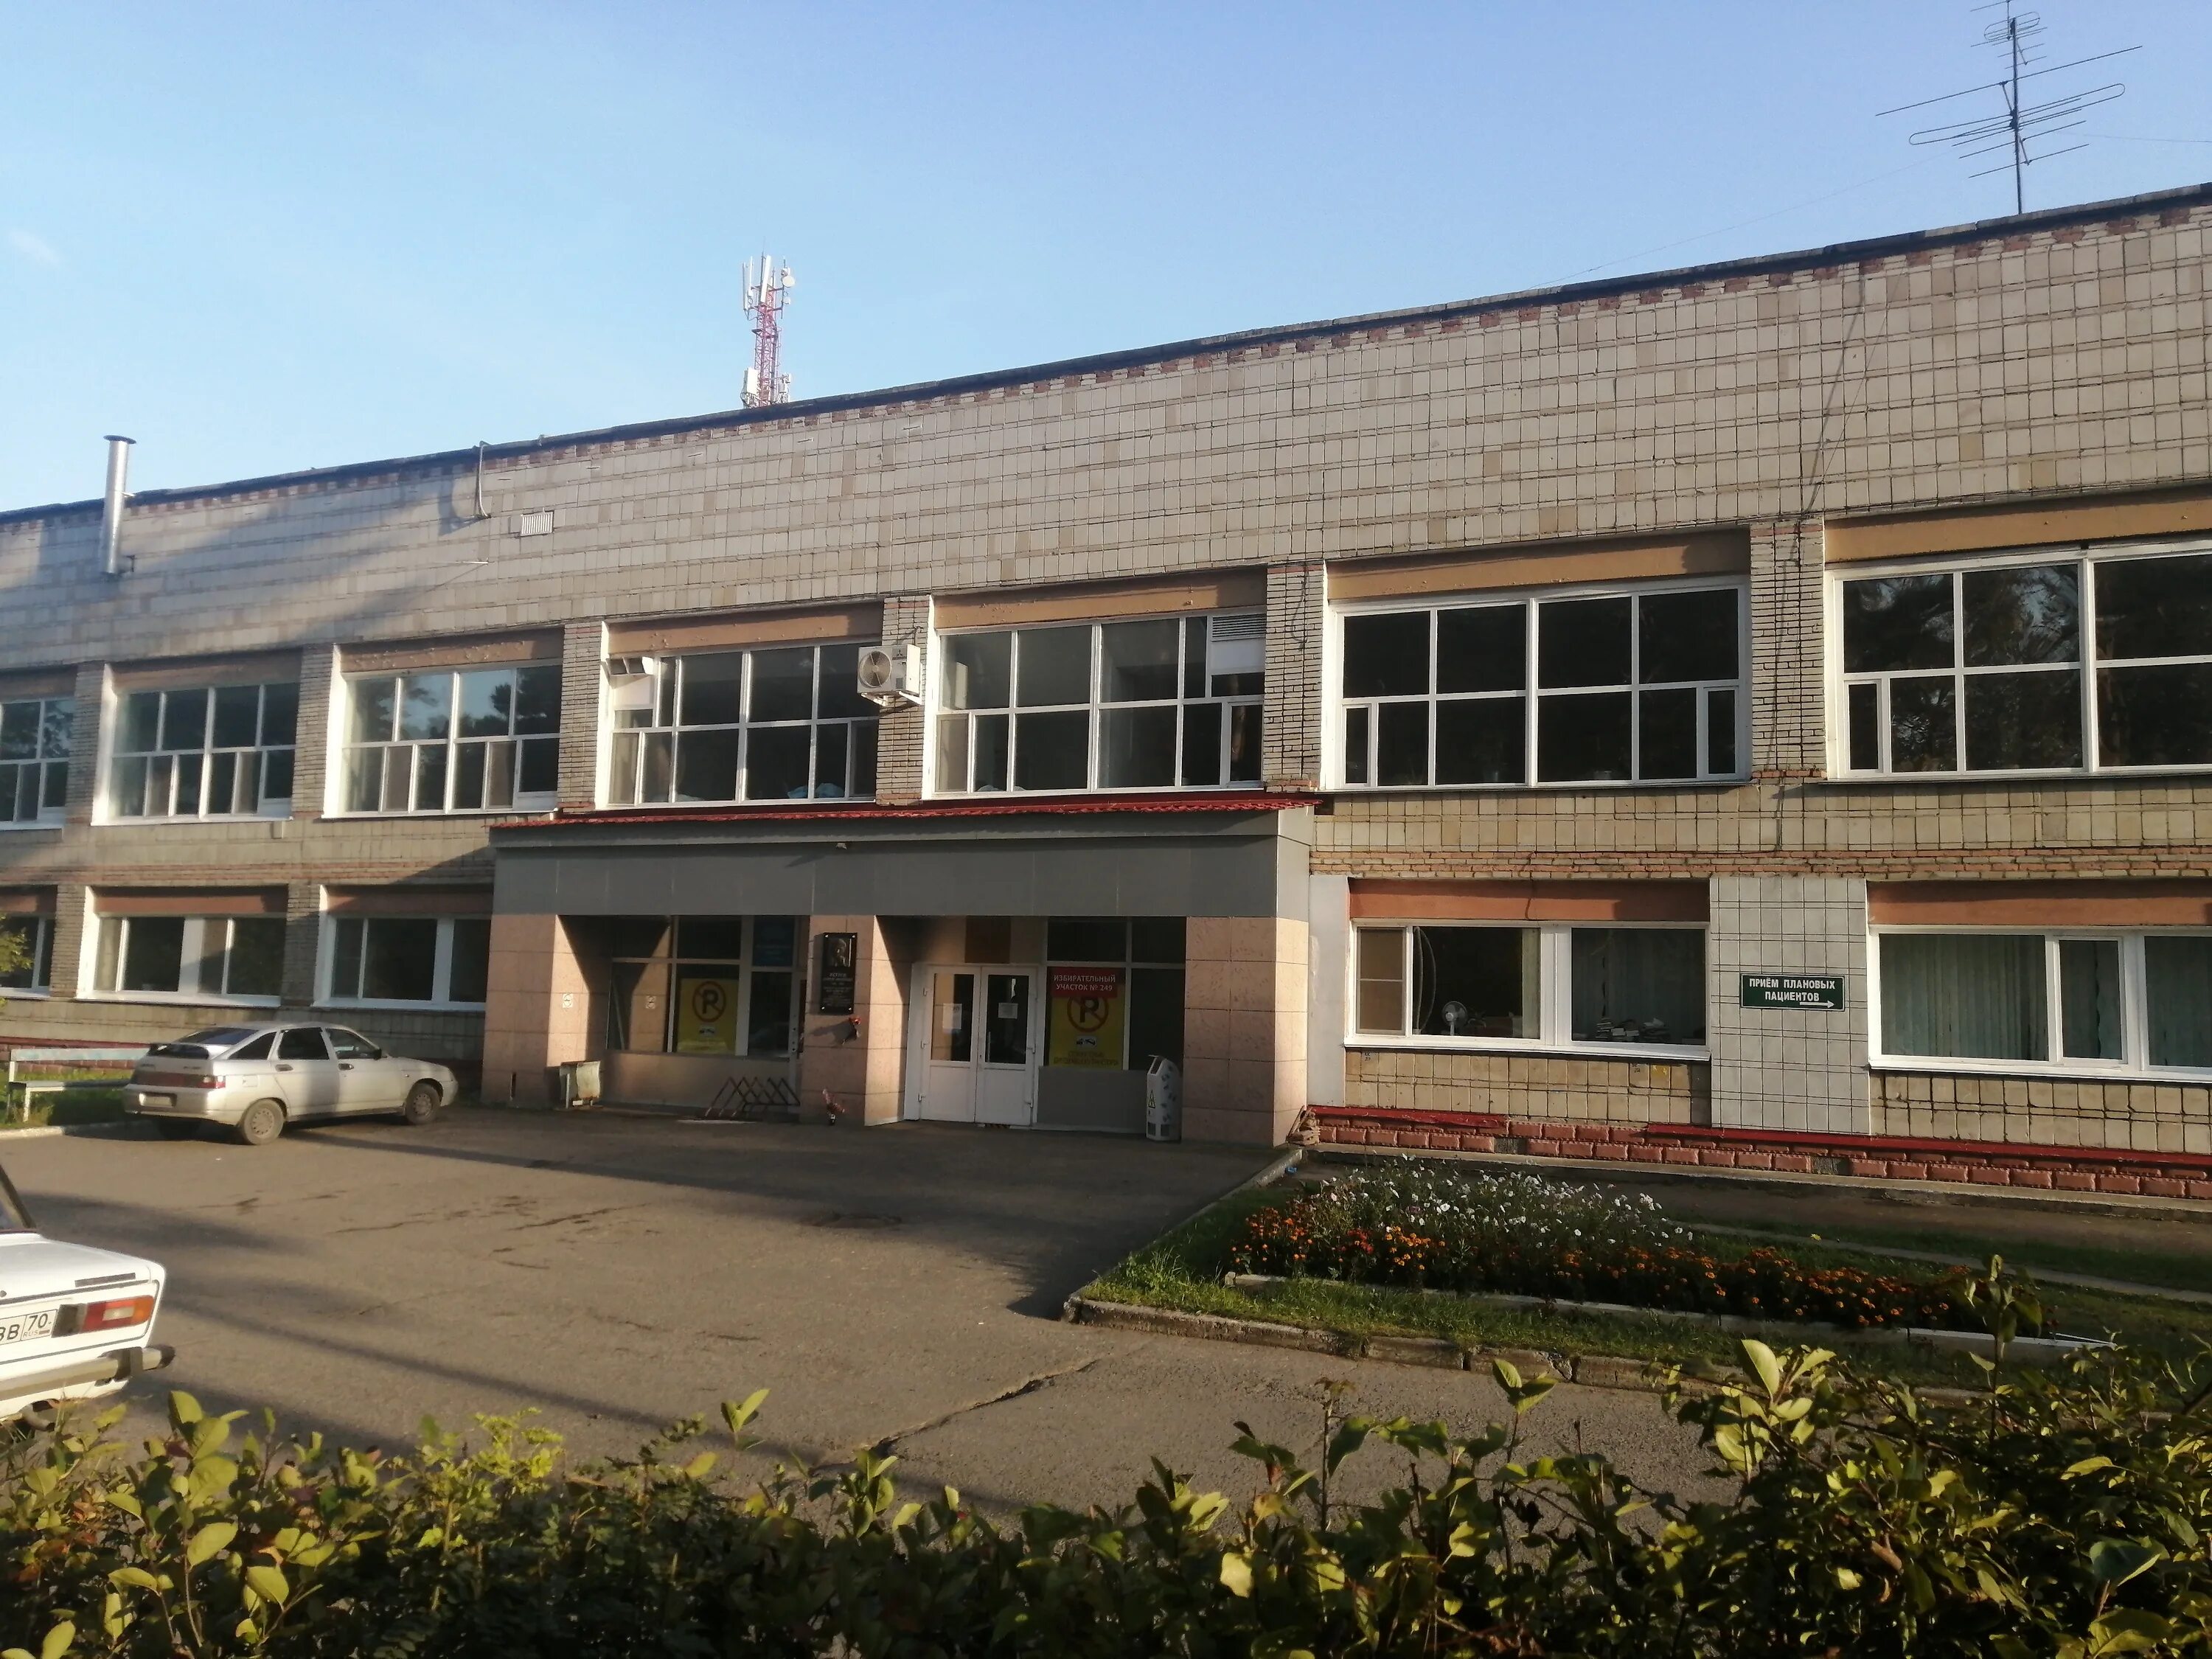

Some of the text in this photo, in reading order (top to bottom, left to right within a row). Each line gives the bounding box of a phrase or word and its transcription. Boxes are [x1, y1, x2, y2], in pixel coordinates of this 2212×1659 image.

[1054, 974, 1116, 983] ИЗБИРАТЕЛЬНЫЙ
[1749, 977, 1836, 990] ПРИЁМ ПЛАНОВЫХ
[1764, 991, 1820, 1002] ПАЦИЕНТОВ
[28, 1313, 49, 1332] 70
[23, 1329, 38, 1338] RUS
